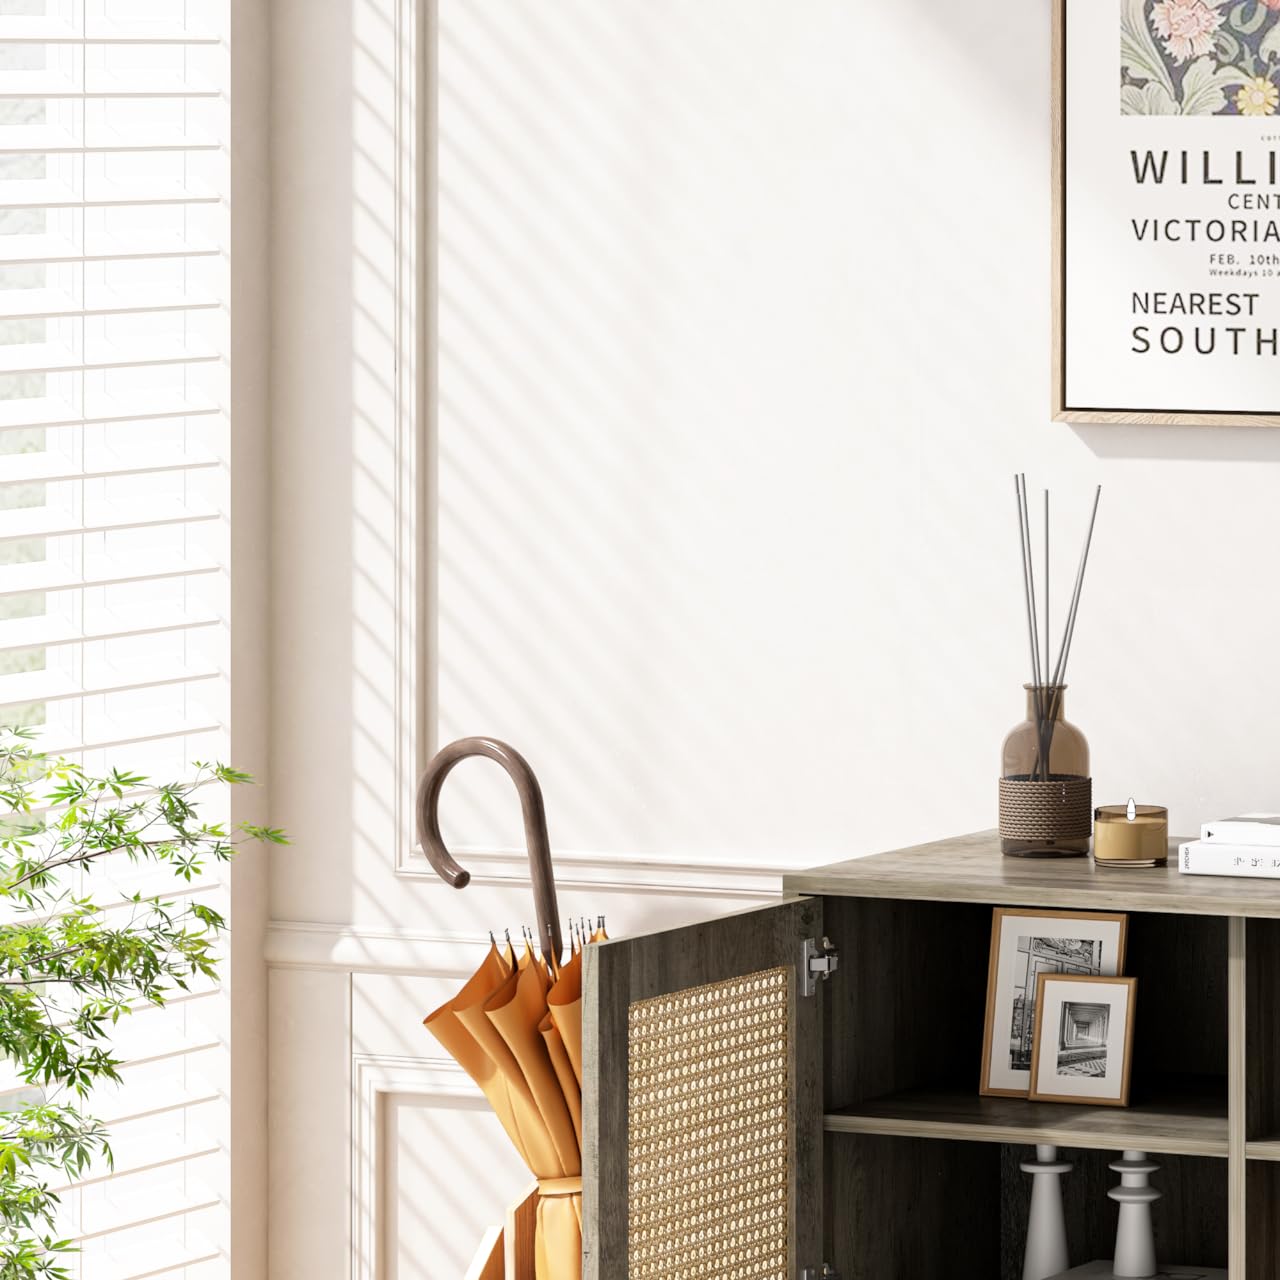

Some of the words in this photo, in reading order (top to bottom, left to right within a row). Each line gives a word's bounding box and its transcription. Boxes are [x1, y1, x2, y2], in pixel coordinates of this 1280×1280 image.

[1209, 254, 1240, 265] FEB.
[1250, 254, 1280, 265] 10th
[1209, 269, 1258, 279] Weekdays
[1132, 292, 1260, 317] NEAREST
[1131, 325, 1279, 357] SOUTH
